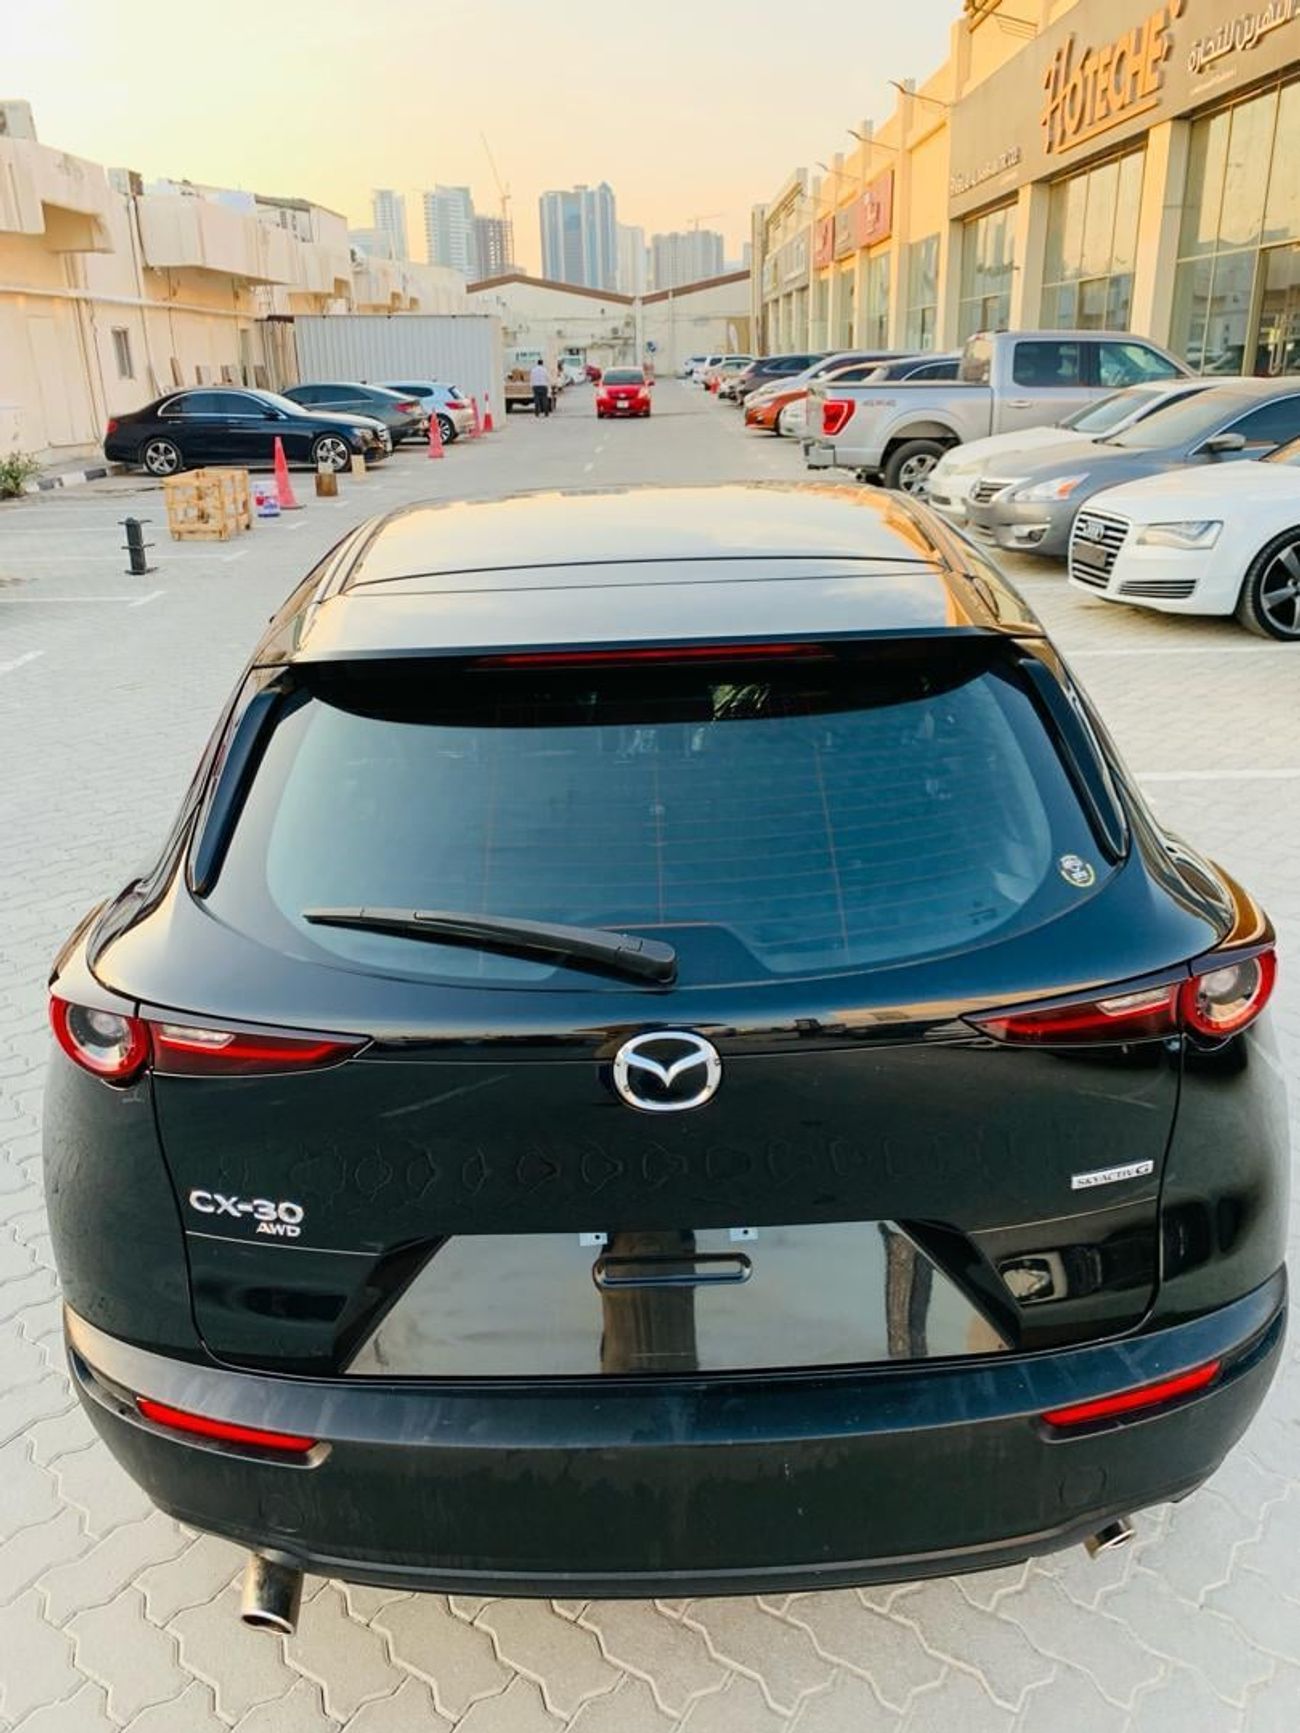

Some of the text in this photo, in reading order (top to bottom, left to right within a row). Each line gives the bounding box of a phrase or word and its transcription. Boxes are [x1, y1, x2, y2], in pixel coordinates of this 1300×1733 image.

[1041, 9, 1170, 154] HOTECHE
[189, 1190, 304, 1224] CX-30
[256, 1222, 301, 1237] AWD
